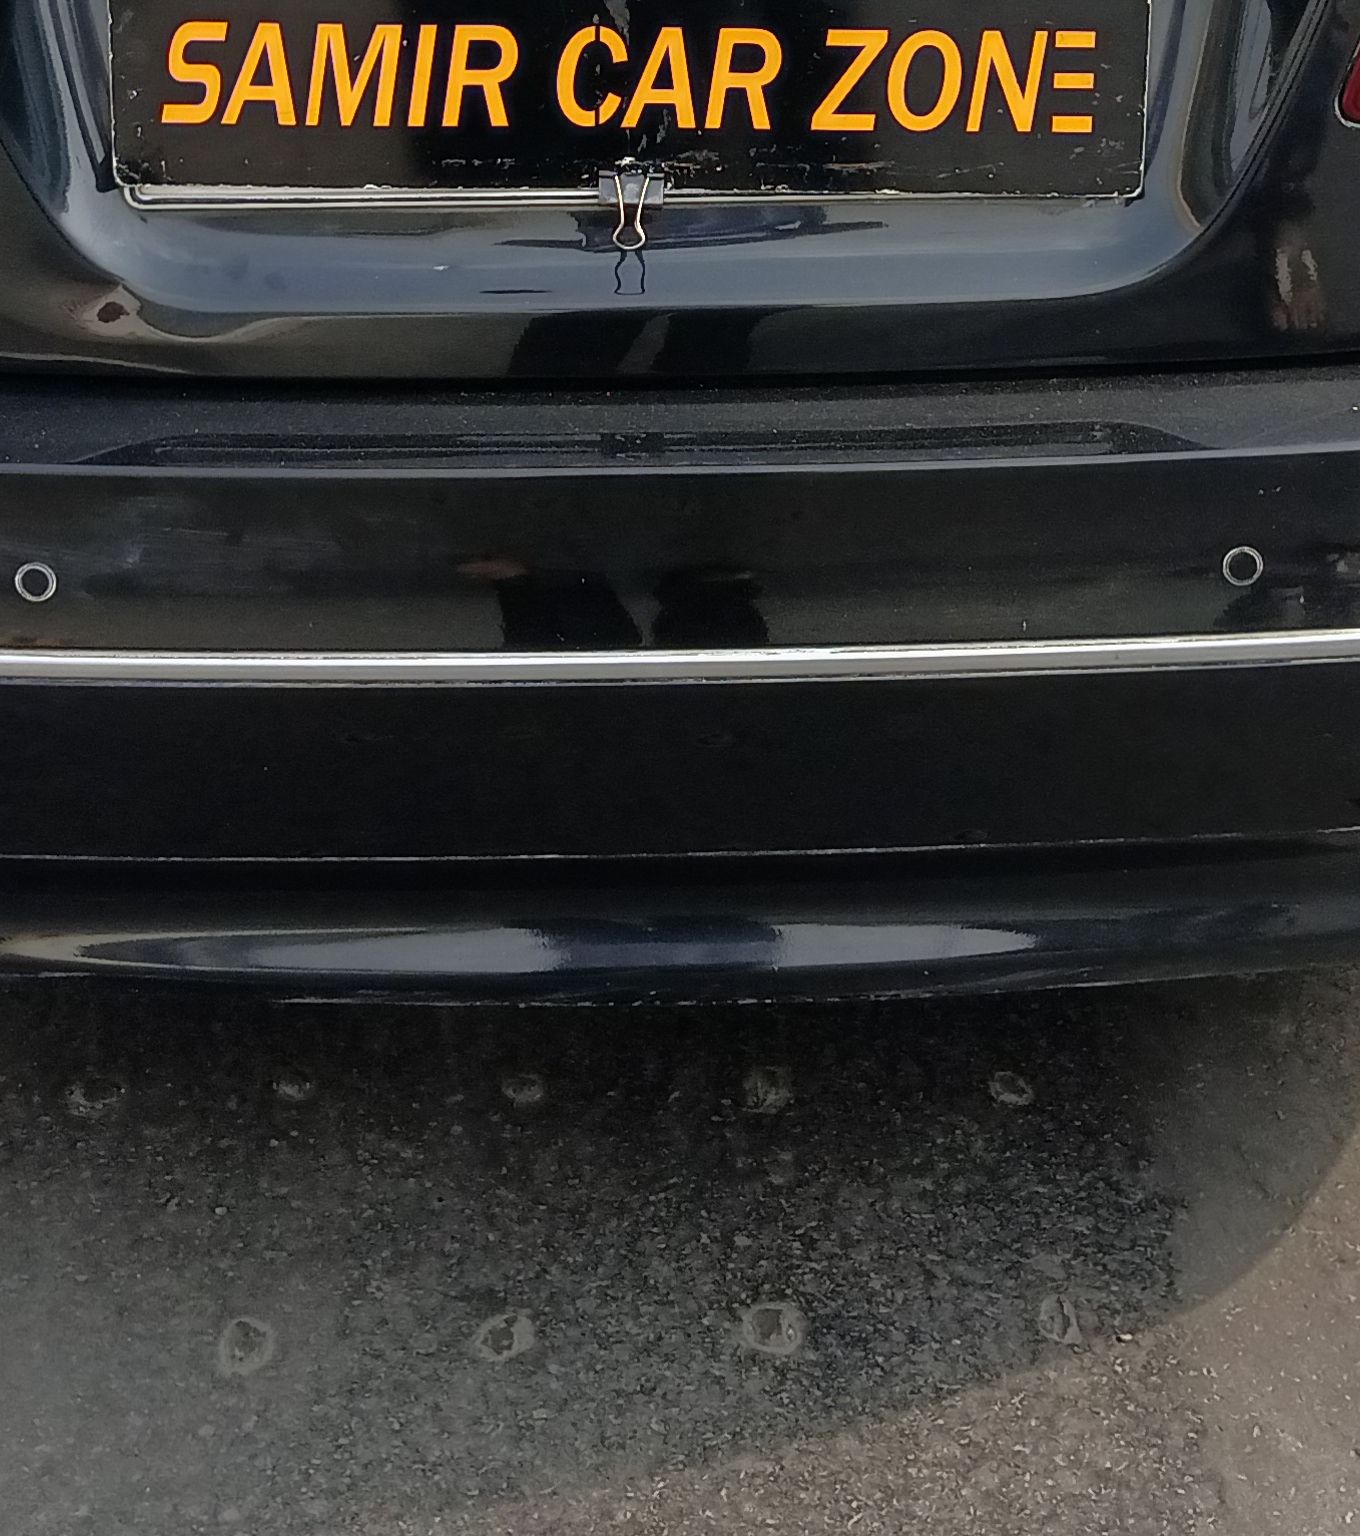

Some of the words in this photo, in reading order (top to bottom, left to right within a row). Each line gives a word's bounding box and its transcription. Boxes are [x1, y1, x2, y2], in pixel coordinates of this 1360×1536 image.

[161, 20, 518, 128] SAMIR
[557, 25, 783, 131] CAR
[810, 28, 1096, 135] ZONE
